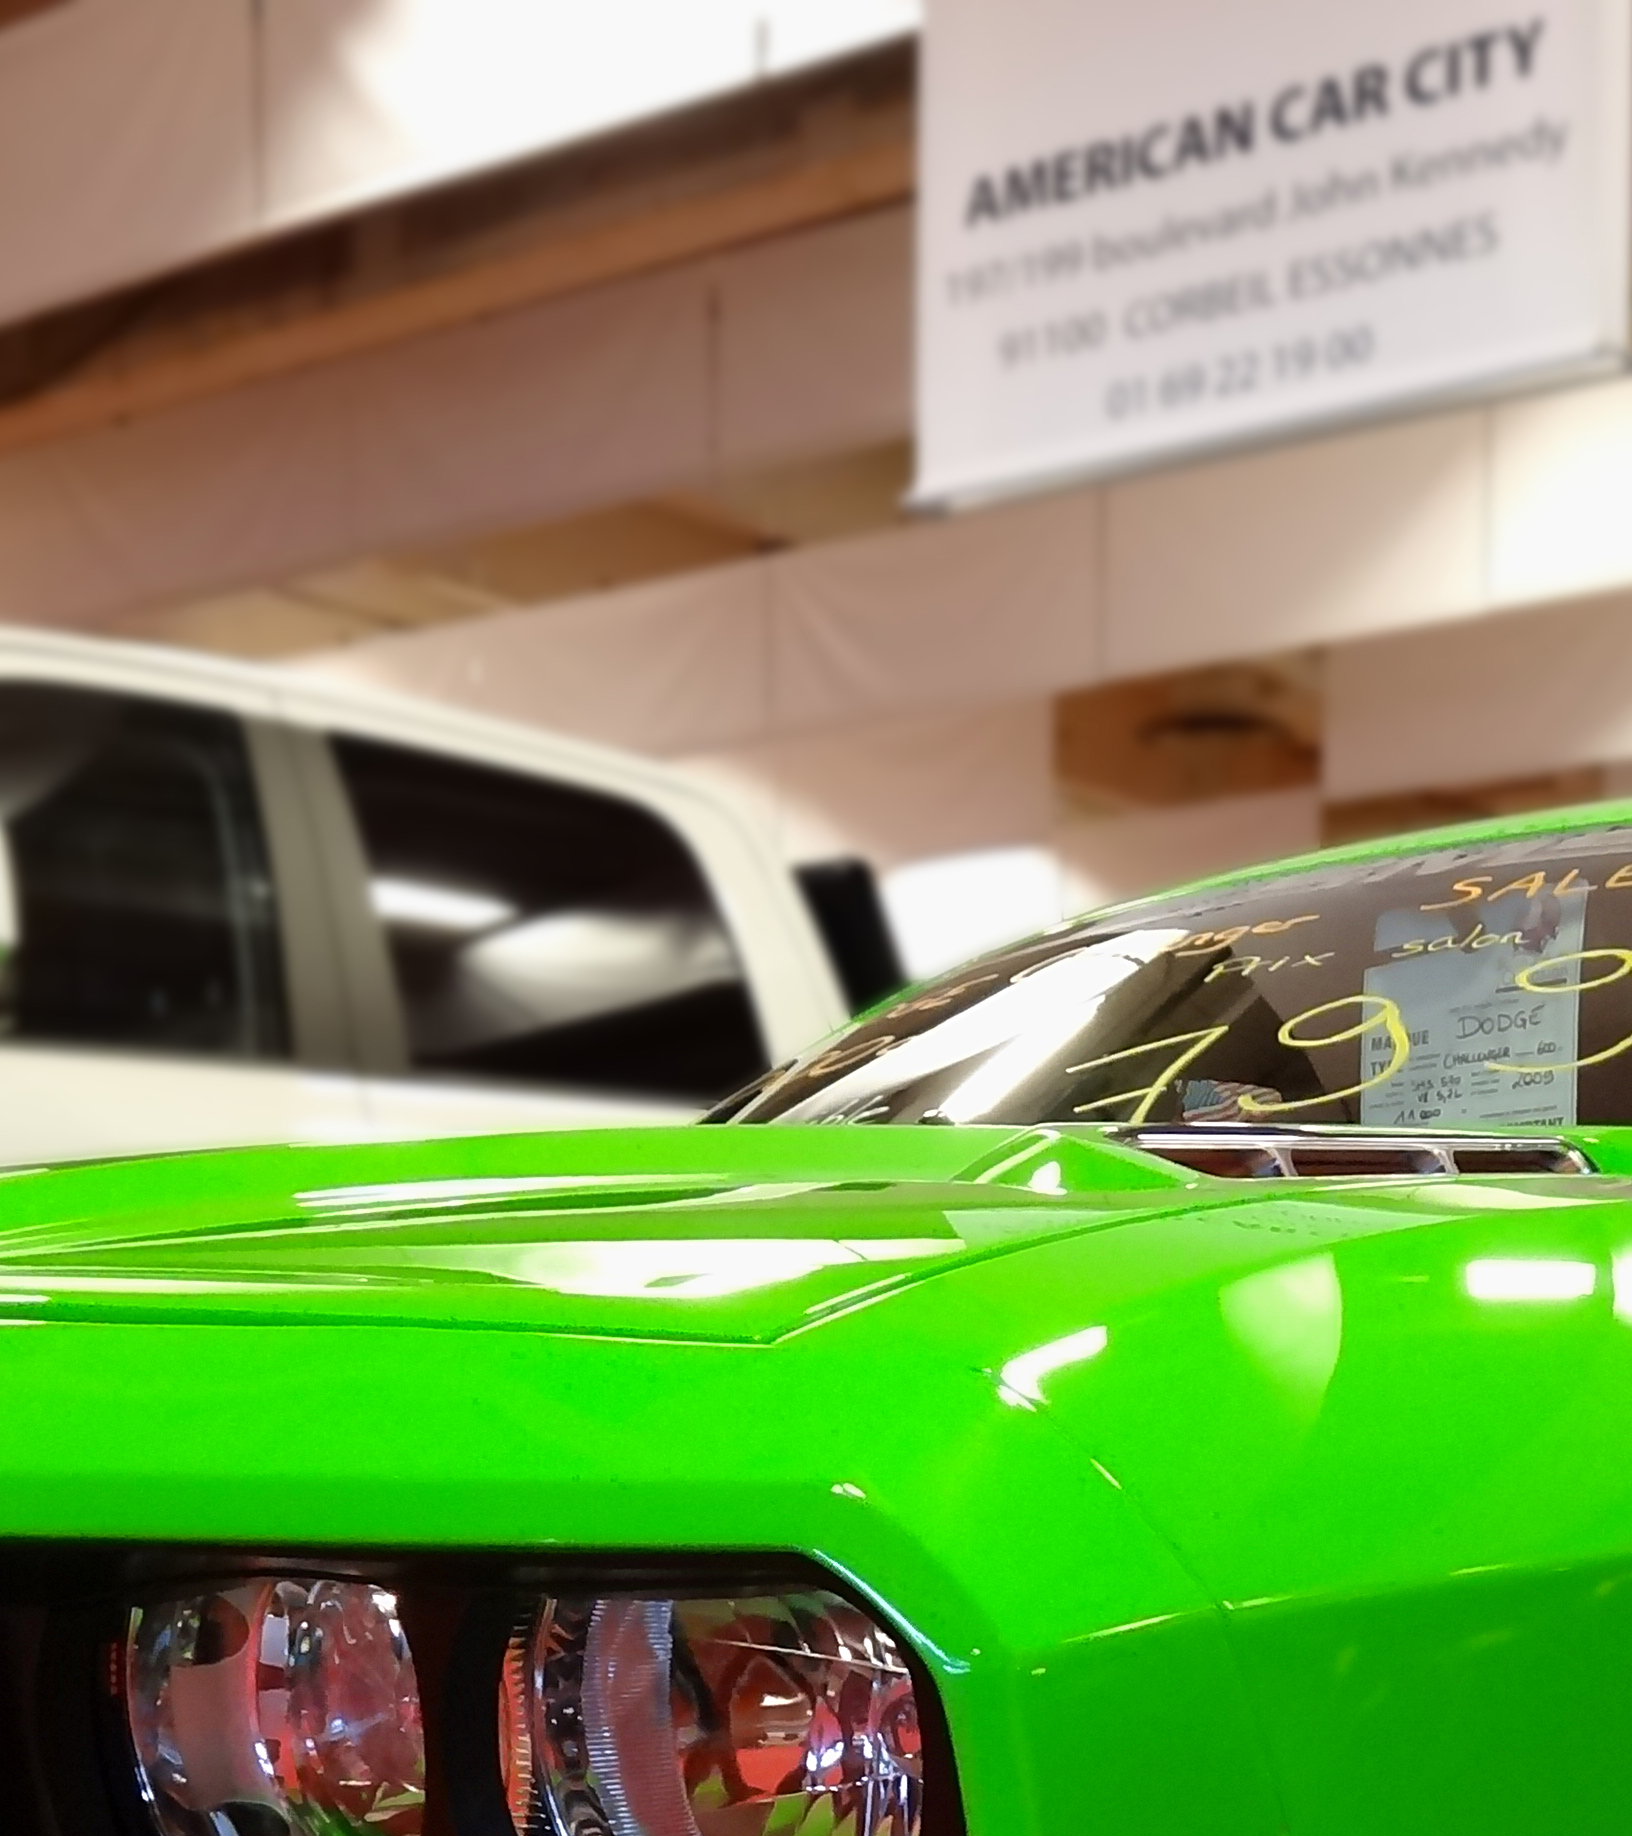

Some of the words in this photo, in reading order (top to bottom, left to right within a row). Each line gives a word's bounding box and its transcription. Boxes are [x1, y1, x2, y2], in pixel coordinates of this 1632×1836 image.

[963, 100, 1257, 231] AMERICAN
[1266, 62, 1391, 147] CAR
[1402, 18, 1547, 109] CITY
[1091, 184, 1278, 276] boulevard
[1286, 165, 1380, 222] John
[1387, 110, 1570, 193] Kennedy
[1122, 265, 1275, 342] CORBEIL
[1286, 211, 1500, 302] ESSONNES
[1215, 347, 1261, 398] 22
[1271, 333, 1318, 383] 19
[1324, 322, 1377, 372] 00
[1455, 1003, 1547, 1040] DODGE
